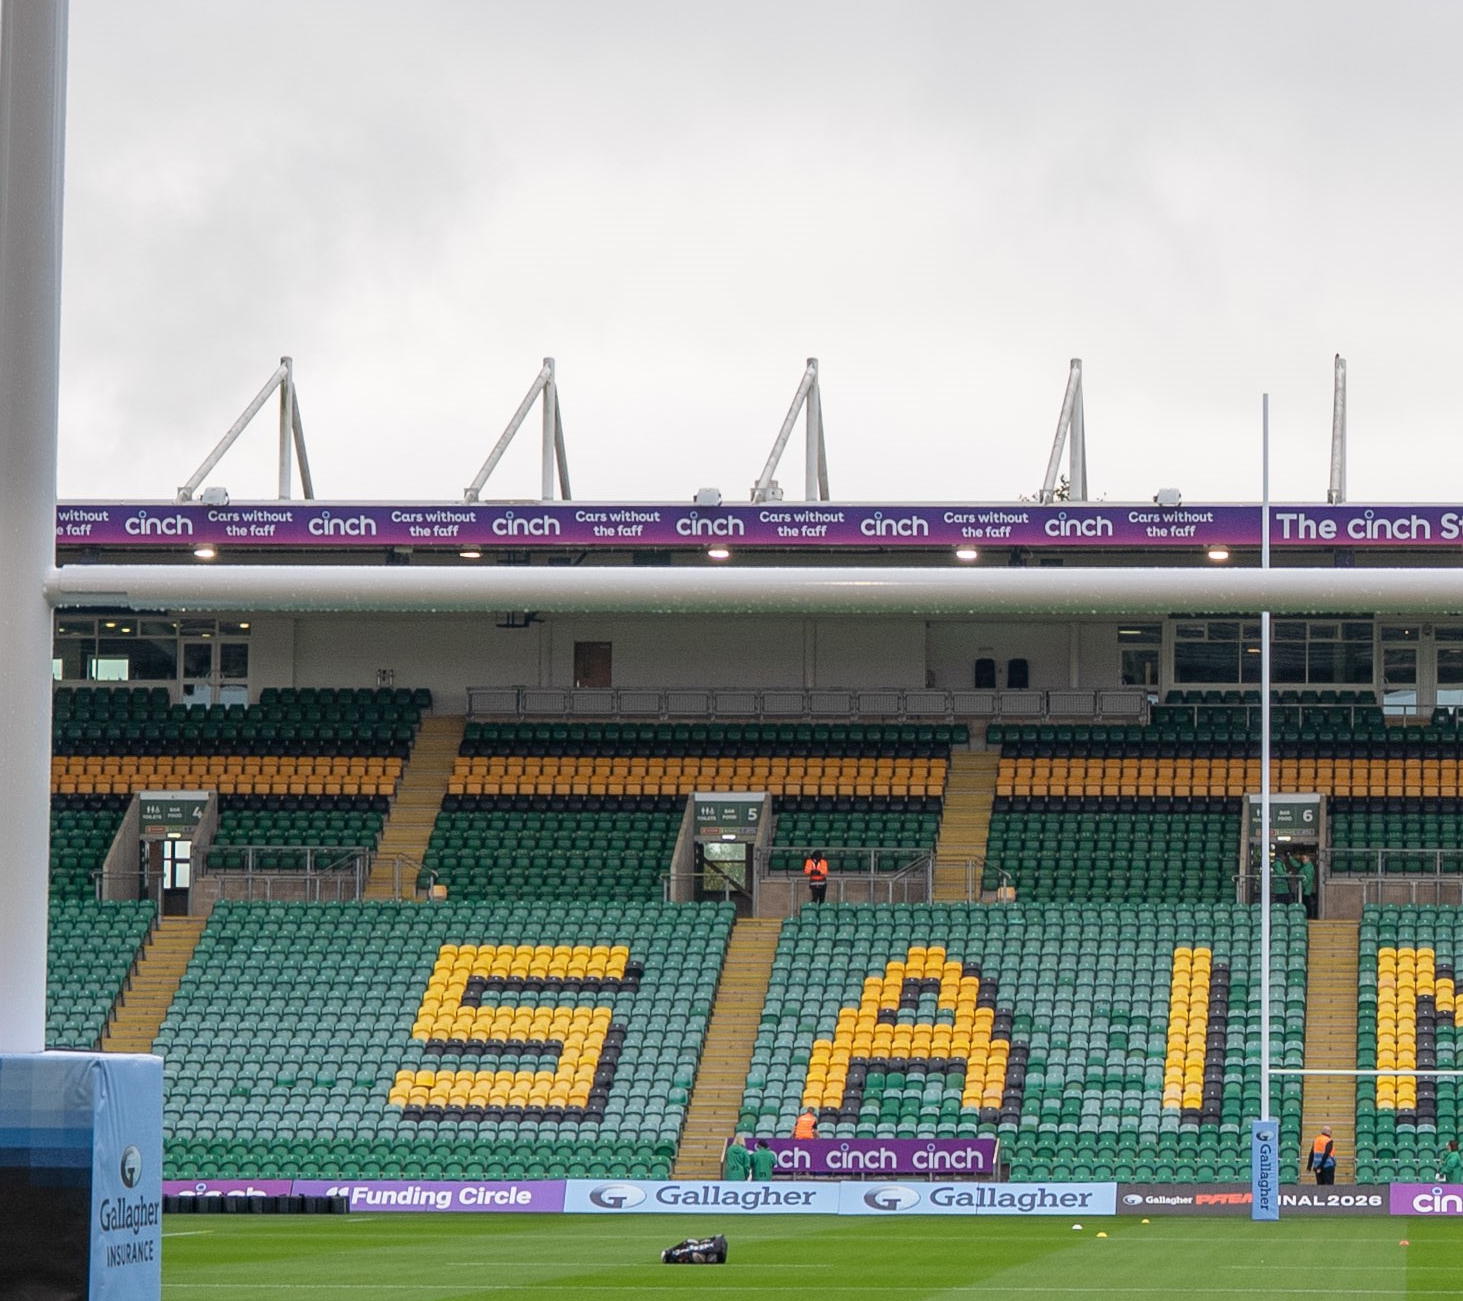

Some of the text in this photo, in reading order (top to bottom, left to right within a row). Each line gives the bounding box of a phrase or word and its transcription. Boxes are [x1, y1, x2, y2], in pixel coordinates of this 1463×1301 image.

[125, 510, 192, 535] cinch
[309, 511, 376, 536] cinch
[492, 511, 560, 537] cinch
[676, 511, 744, 537] cinch
[860, 511, 928, 537] cinch
[1045, 511, 1112, 537] cinch
[1128, 512, 1212, 523] Cars without
[1276, 513, 1336, 539] The
[1347, 509, 1430, 539] cinch
[1146, 526, 1194, 537] the faff
[192, 806, 202, 818] 4
[748, 808, 757, 821] 5
[1302, 809, 1313, 822] 6
[826, 1142, 896, 1169] cinch
[913, 1142, 983, 1169] cinch
[1259, 1144, 1272, 1211] Gallagher
[351, 1186, 532, 1210] Funding Circle
[655, 1184, 817, 1208] Gallagher
[929, 1182, 1093, 1210] Gallagher
[1145, 1194, 1193, 1206] Gallagher
[1277, 1194, 1325, 1206] INAL
[1327, 1194, 1382, 1206] 2026
[98, 1198, 159, 1234] Gallagher
[106, 1239, 154, 1267] INSURANCE
